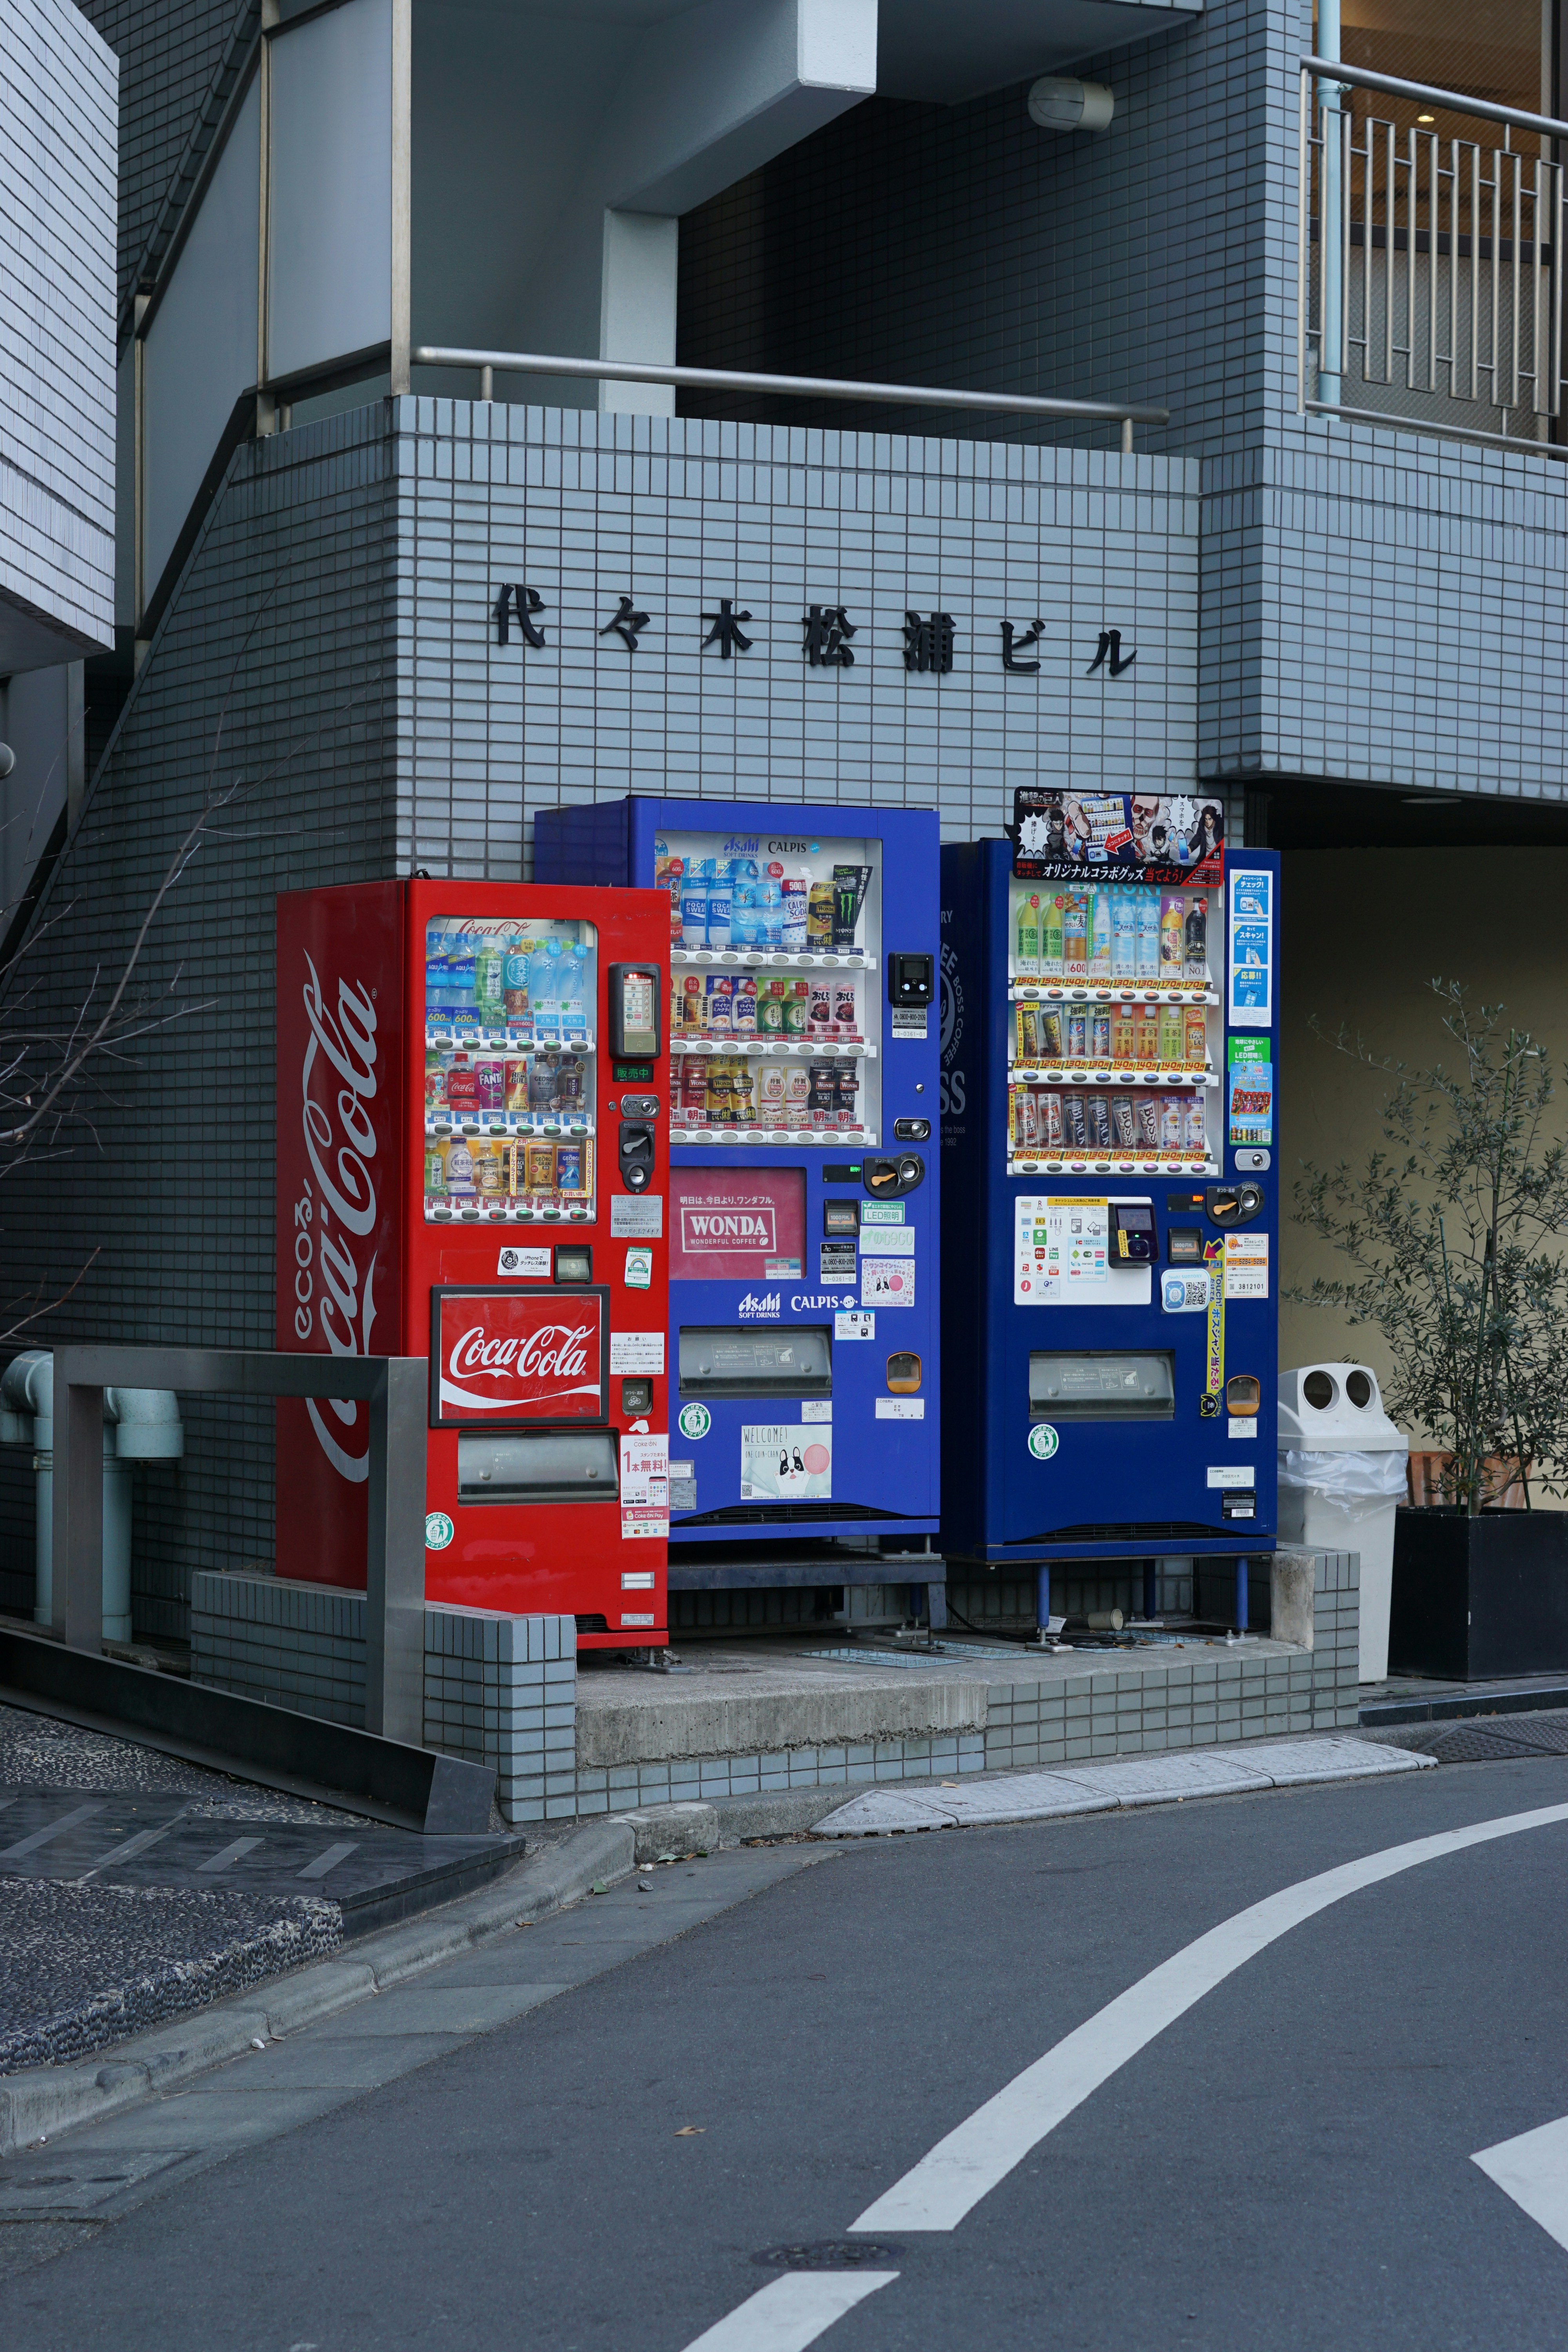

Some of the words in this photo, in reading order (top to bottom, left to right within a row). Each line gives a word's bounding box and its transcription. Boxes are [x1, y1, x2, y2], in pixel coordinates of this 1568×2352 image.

[493, 583, 1138, 677] 代々木松浦ビル
[724, 837, 759, 853] Asahi
[768, 841, 806, 854] CALPIS
[1106, 833, 1130, 848] ココにタッチ!
[670, 881, 678, 902] 麦茶
[857, 867, 869, 905] 野性を解き放て
[515, 958, 527, 983] 麦茶
[1189, 964, 1205, 975] NO.1
[1241, 971, 1261, 980] 応募!!
[953, 975, 964, 1014] BOSS
[428, 1013, 451, 1022] 600ml
[455, 1015, 477, 1023] 600ml
[944, 1020, 964, 1067] COFFEE
[479, 1073, 502, 1085] FANTA
[617, 1068, 648, 1078] 販売中
[687, 1110, 698, 1120] 朝
[813, 1111, 824, 1122] 朝
[838, 1112, 849, 1122] 朝
[944, 1125, 953, 1134] the
[953, 1125, 965, 1134] boss
[1072, 1107, 1085, 1145] BLACK
[1096, 1107, 1110, 1145] BLACK
[1122, 1109, 1132, 1144] BOSS
[1144, 1105, 1157, 1143] BOSS
[944, 1138, 956, 1147] 1992
[680, 1196, 775, 1205] 明日は、今日より、ワンダフル。
[867, 1212, 899, 1220] LED照明
[690, 1216, 768, 1236] WONDA
[739, 1293, 780, 1312] Asahi
[791, 1296, 838, 1311] CALPIS
[449, 1325, 596, 1379] Coca-Cola
[1210, 1308, 1221, 1390] ボスジャン当たる!
[683, 1405, 707, 1416] のんだあとは
[684, 1427, 706, 1437] リサイクル
[744, 1427, 788, 1443] WELCOME!
[1031, 1426, 1054, 1439] のんだあとは
[1034, 1446, 1055, 1457] リサイクル
[623, 1451, 666, 1473] 1本無料!
[426, 1540, 448, 1548] リサイクル
